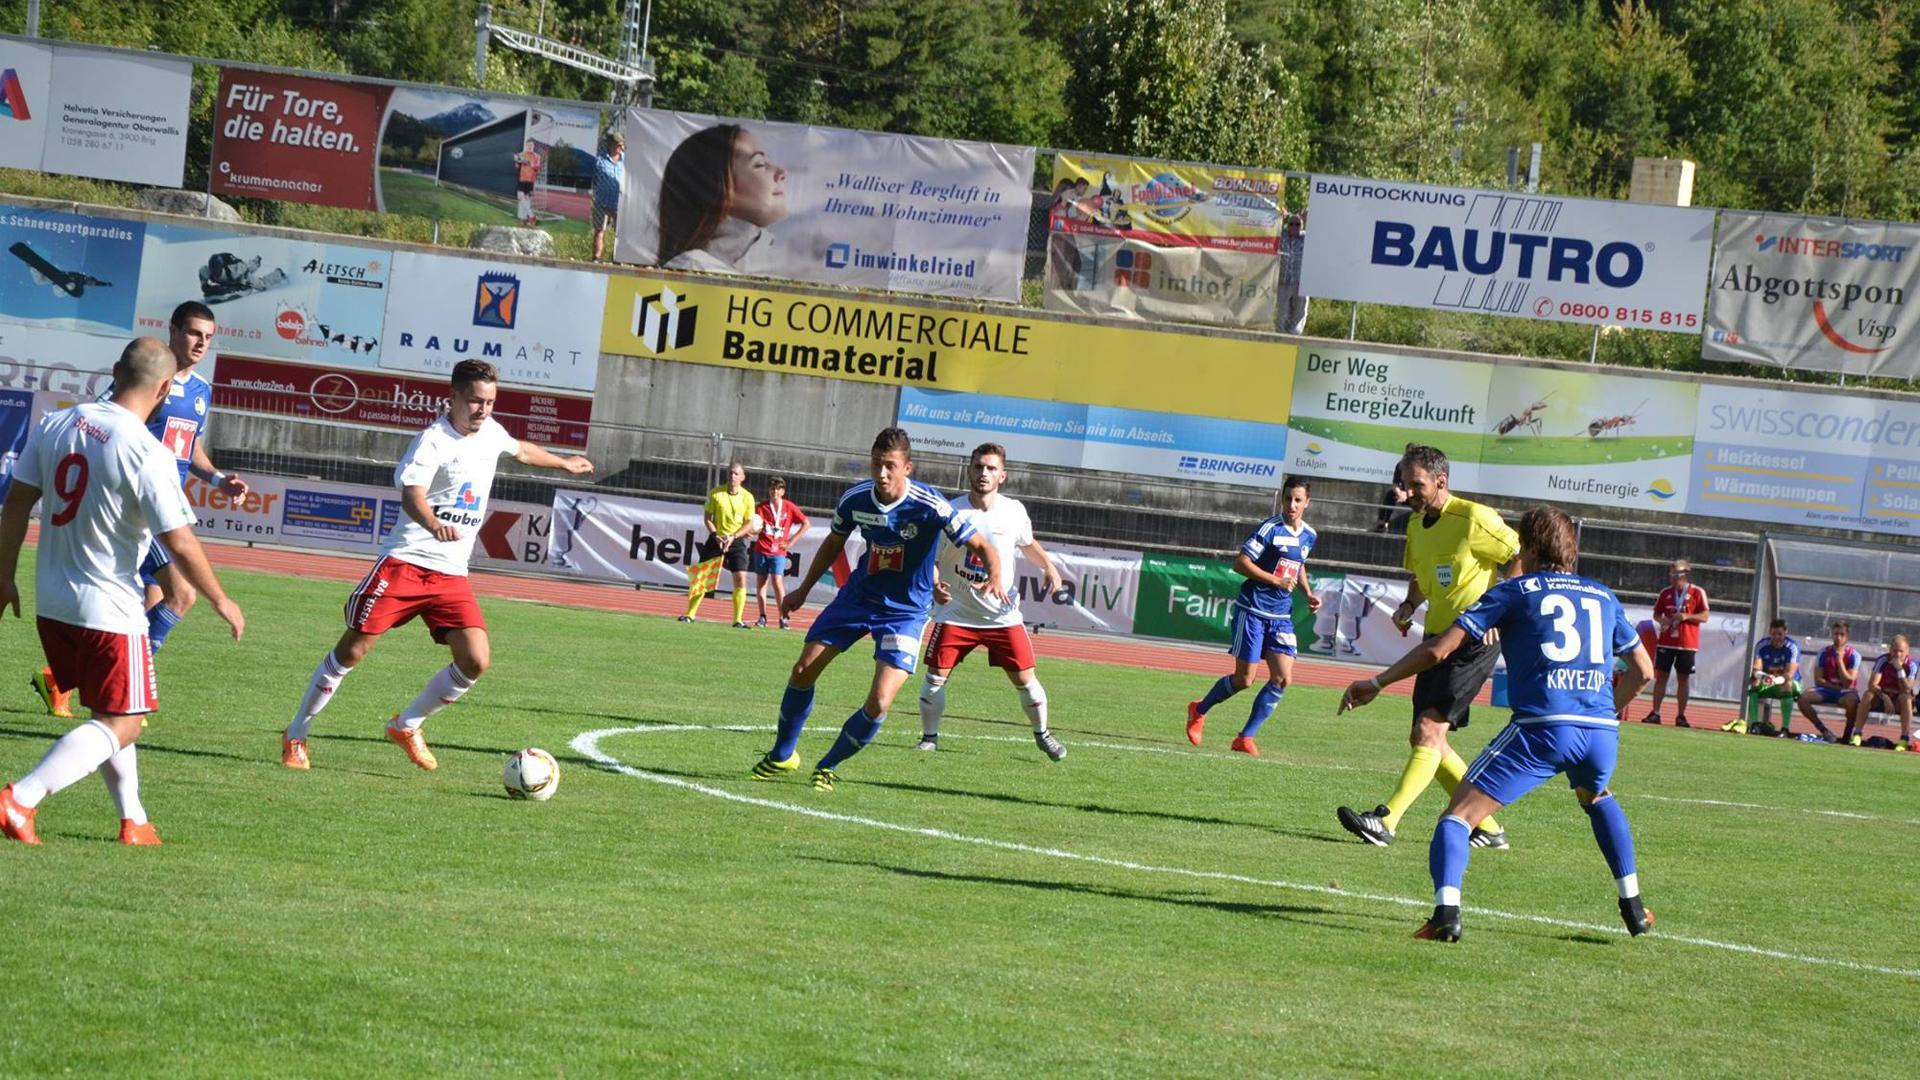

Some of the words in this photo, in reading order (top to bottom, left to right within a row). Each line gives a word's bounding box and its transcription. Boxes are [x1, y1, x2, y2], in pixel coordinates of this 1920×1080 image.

[63, 103, 99, 115] Helvetia
[101, 108, 167, 124] Versicherungen
[226, 84, 274, 112] Für
[283, 90, 344, 125] Tore,
[62, 114, 129, 130] Generalagentur
[132, 123, 180, 136] Oberwallis
[224, 114, 264, 140] die
[271, 118, 360, 153] halten.
[909, 179, 979, 203] Bergluft
[983, 187, 1001, 203] in
[1213, 177, 1278, 193] BOWLING
[1315, 181, 1466, 207] BAUTROCKNUNG
[824, 197, 875, 217] Ihrem
[10, 215, 133, 241] Schneesportparadies
[1371, 220, 1644, 288] BAUTRO
[1779, 235, 1907, 263] INTERSPORT
[302, 258, 367, 279] ALETSCH
[854, 249, 975, 278] imwinkelried
[1719, 264, 1905, 310] Abgottspon
[726, 294, 773, 327] HG
[787, 301, 1032, 356] COMMERCIALE
[1560, 301, 1610, 320] 0800
[1615, 307, 1654, 324] 815
[1660, 310, 1697, 327] 815
[1857, 318, 1897, 343] Visp
[722, 330, 938, 382] Baumaterial
[1307, 353, 1341, 374] Der
[1348, 357, 1389, 383] Weg
[1343, 379, 1356, 392] in
[1358, 381, 1378, 396] die
[1381, 383, 1425, 400] sichere
[1326, 392, 1476, 425] EnergieZukunft
[905, 403, 927, 418] Mit
[928, 409, 951, 421] uns
[953, 410, 972, 423] als
[974, 410, 1019, 427] Partner
[1021, 417, 1062, 433] stehen
[1064, 421, 1084, 434] Sie
[1087, 423, 1107, 436] nie
[1110, 425, 1124, 438] im
[1127, 429, 1175, 444] Abseits.
[1200, 459, 1276, 477] BRINGHEN
[1295, 457, 1327, 470] EnAlpin
[1717, 448, 1805, 470] Heizkessel
[51, 453, 88, 526] 9
[1548, 474, 1640, 499] NaturEnergie
[1714, 476, 1838, 504] Wärmepumpen
[225, 519, 274, 534] Türen
[1540, 594, 1605, 664] 31
